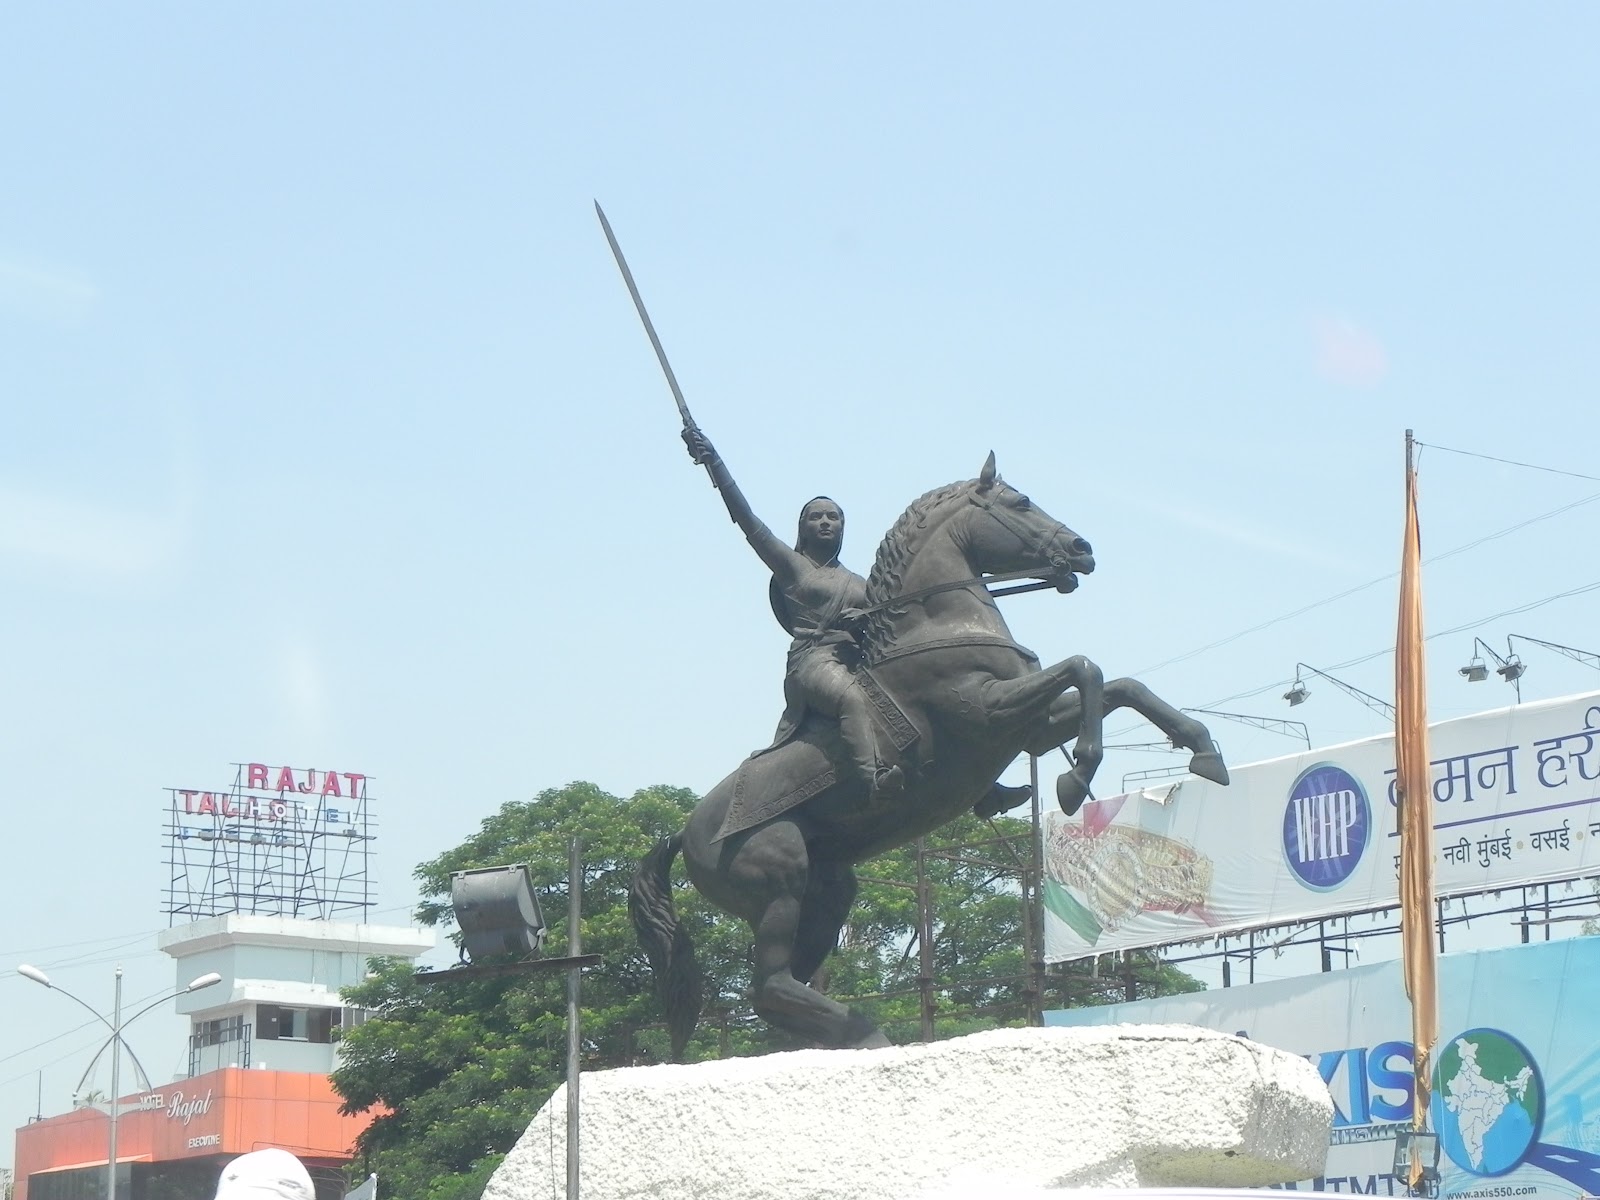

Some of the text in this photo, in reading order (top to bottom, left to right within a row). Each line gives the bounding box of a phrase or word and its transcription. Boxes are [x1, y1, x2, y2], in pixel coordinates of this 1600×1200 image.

[248, 763, 365, 799] RAJAT
[249, 800, 360, 825] HOTEL
[1293, 788, 1357, 864] WHP
[1442, 836, 1471, 865] नवी
[1477, 828, 1512, 868] मुंबई
[1530, 819, 1570, 852] वसई
[166, 1088, 213, 1126] Rajat
[188, 1134, 220, 1149] EXECUTIVE
[1446, 1185, 1538, 1200] www.axis550.com
